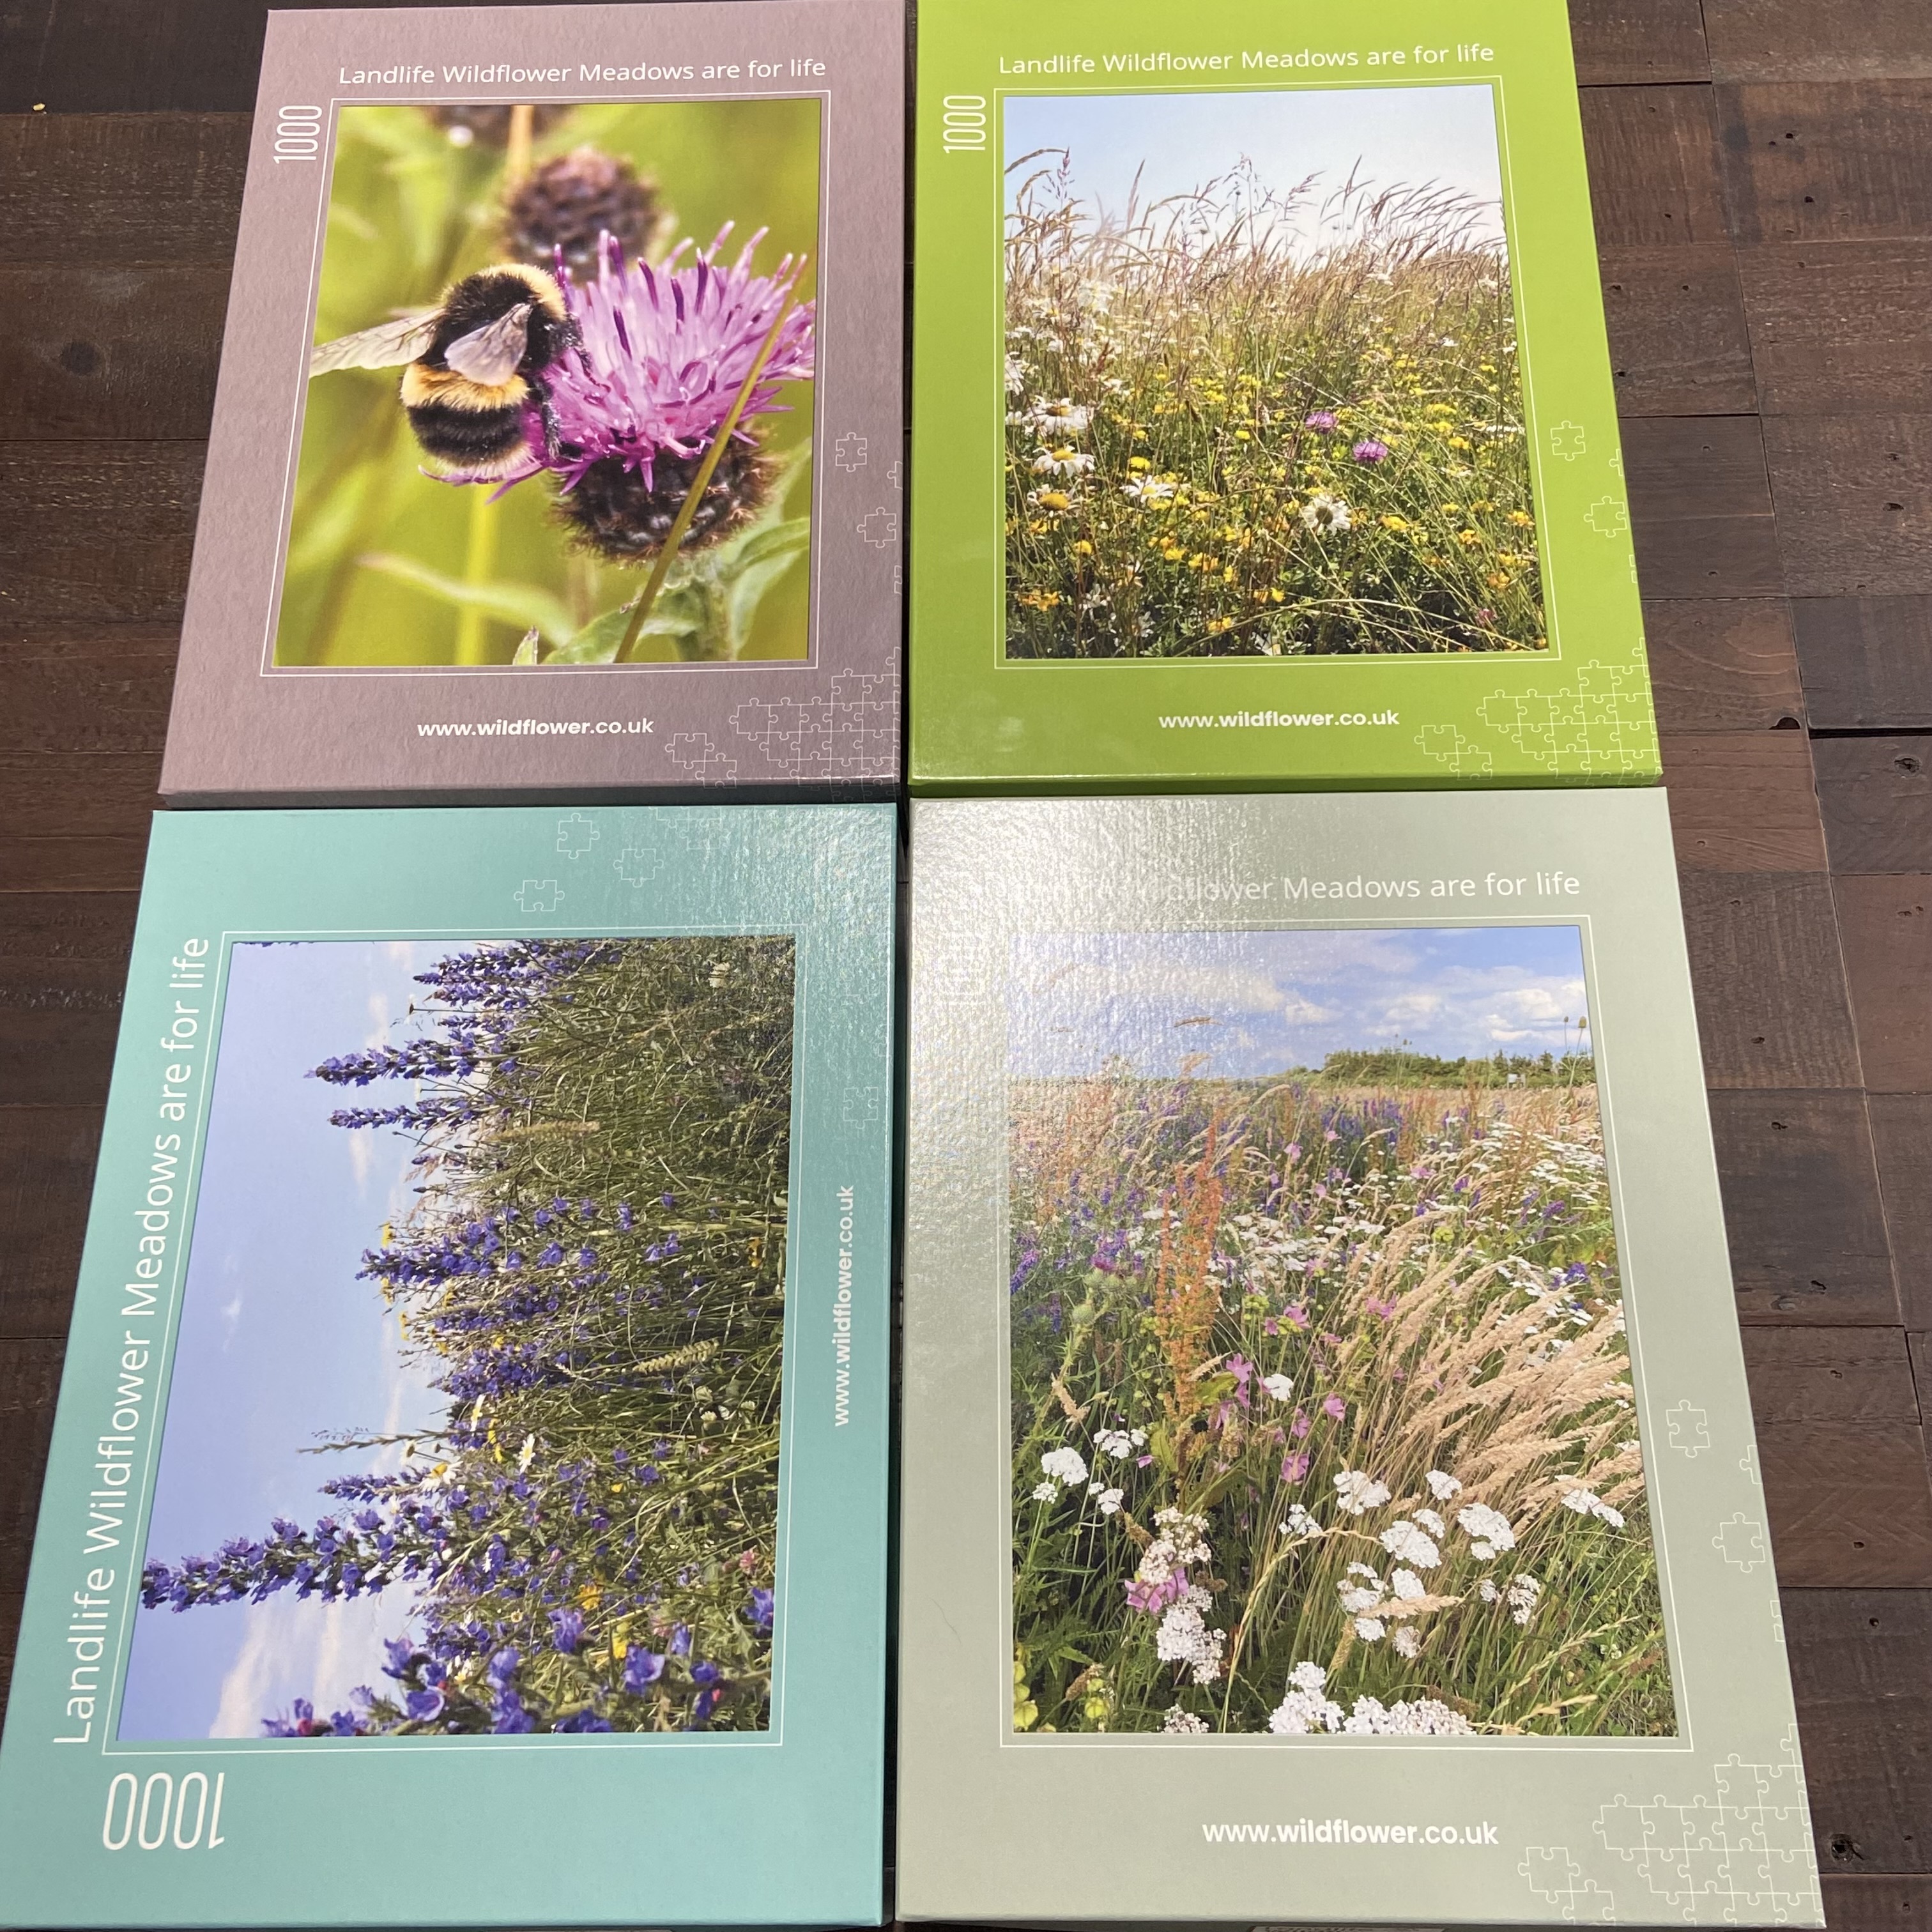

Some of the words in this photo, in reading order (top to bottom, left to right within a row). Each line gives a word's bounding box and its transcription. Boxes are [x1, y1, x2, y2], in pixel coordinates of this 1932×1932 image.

[339, 65, 436, 85] Landlife
[441, 63, 573, 84] Wildflower
[579, 61, 694, 82] Meadows
[701, 64, 741, 80] are
[747, 59, 784, 79] for
[790, 57, 827, 78] life
[999, 54, 1096, 74] Landlife
[1101, 52, 1234, 73] Wildflower
[1241, 48, 1360, 70] Meadows
[1366, 50, 1406, 66] are
[1412, 45, 1450, 65] for
[1457, 42, 1494, 63] life
[272, 105, 323, 165] 1000
[942, 95, 987, 155] 1000
[416, 716, 655, 737] www.wildflower.co.uk
[1158, 709, 1400, 729] www.wildflower.co.uk
[1283, 874, 1421, 900] Meadows
[1430, 878, 1476, 898] are
[1483, 871, 1528, 896] for
[1536, 870, 1581, 896] life
[169, 938, 210, 988] life
[160, 999, 200, 1053] for
[159, 1063, 192, 1122] are
[120, 1133, 181, 1316] Meadows
[831, 1184, 855, 1428] www.wildflower.co.uk
[82, 1330, 151, 1555] Wildflower
[52, 1566, 116, 1744] Landlife
[102, 1771, 226, 1851] 1000
[1201, 1817, 1499, 1845] www.wildflower.co.uk
